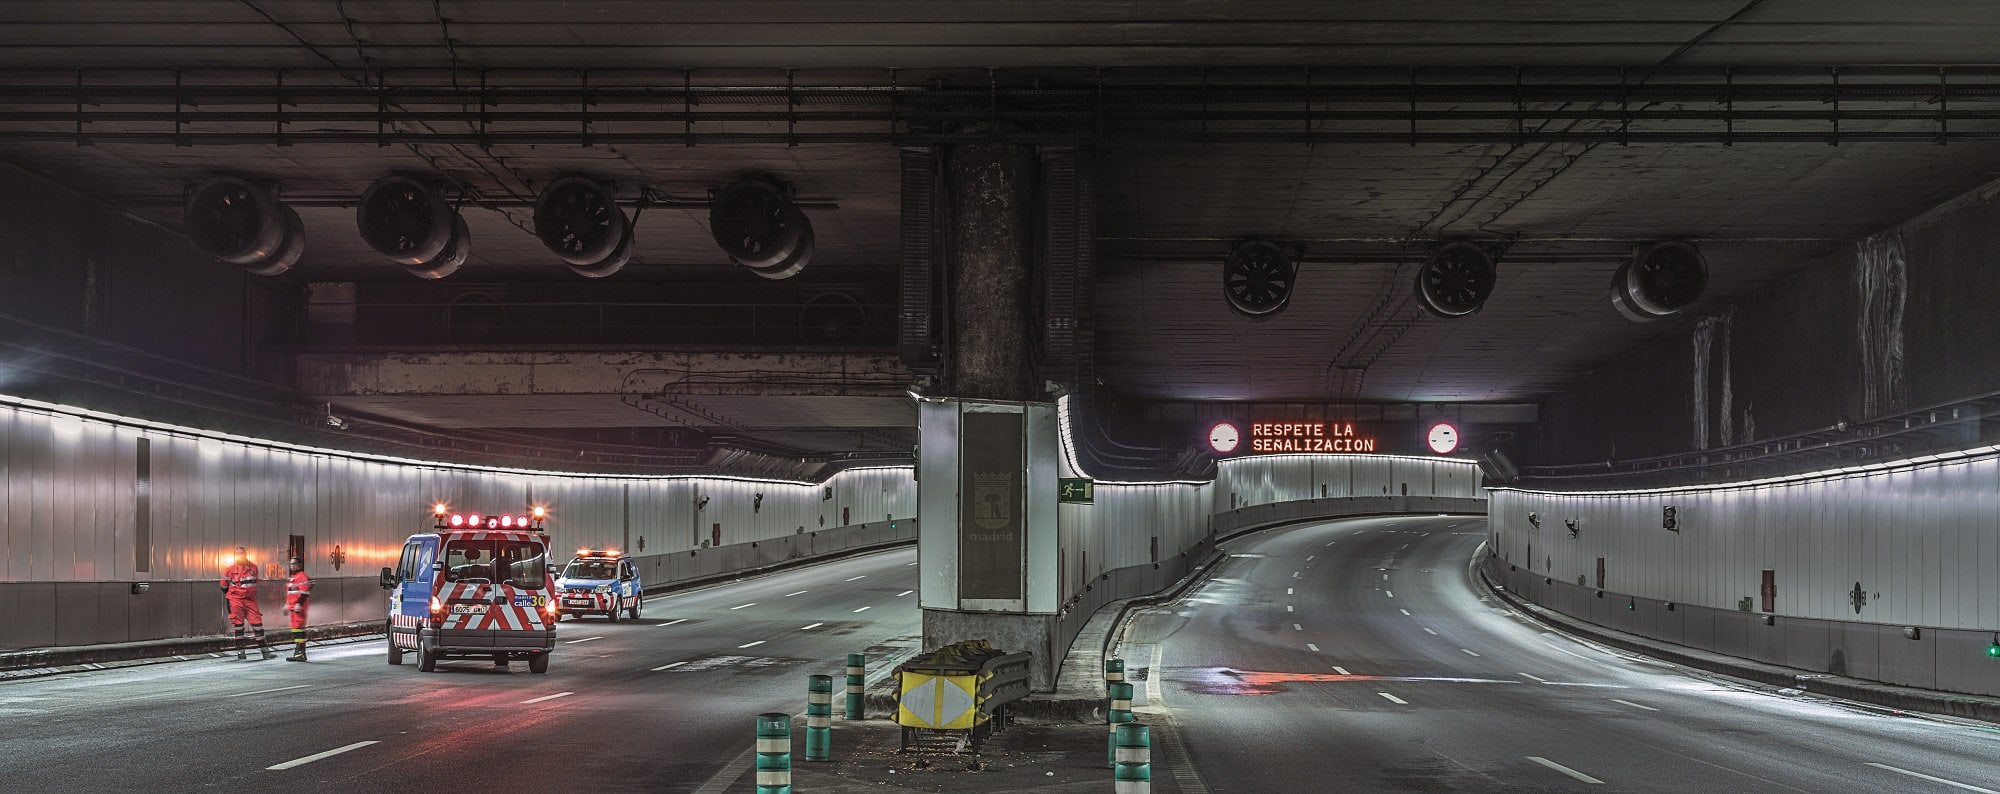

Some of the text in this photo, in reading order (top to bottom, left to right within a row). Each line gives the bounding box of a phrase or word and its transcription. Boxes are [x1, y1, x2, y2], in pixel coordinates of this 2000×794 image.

[1253, 424, 1353, 436] RESPETE LA
[1253, 438, 1374, 452] SEÑALIZACION
[969, 531, 1013, 541] madrid
